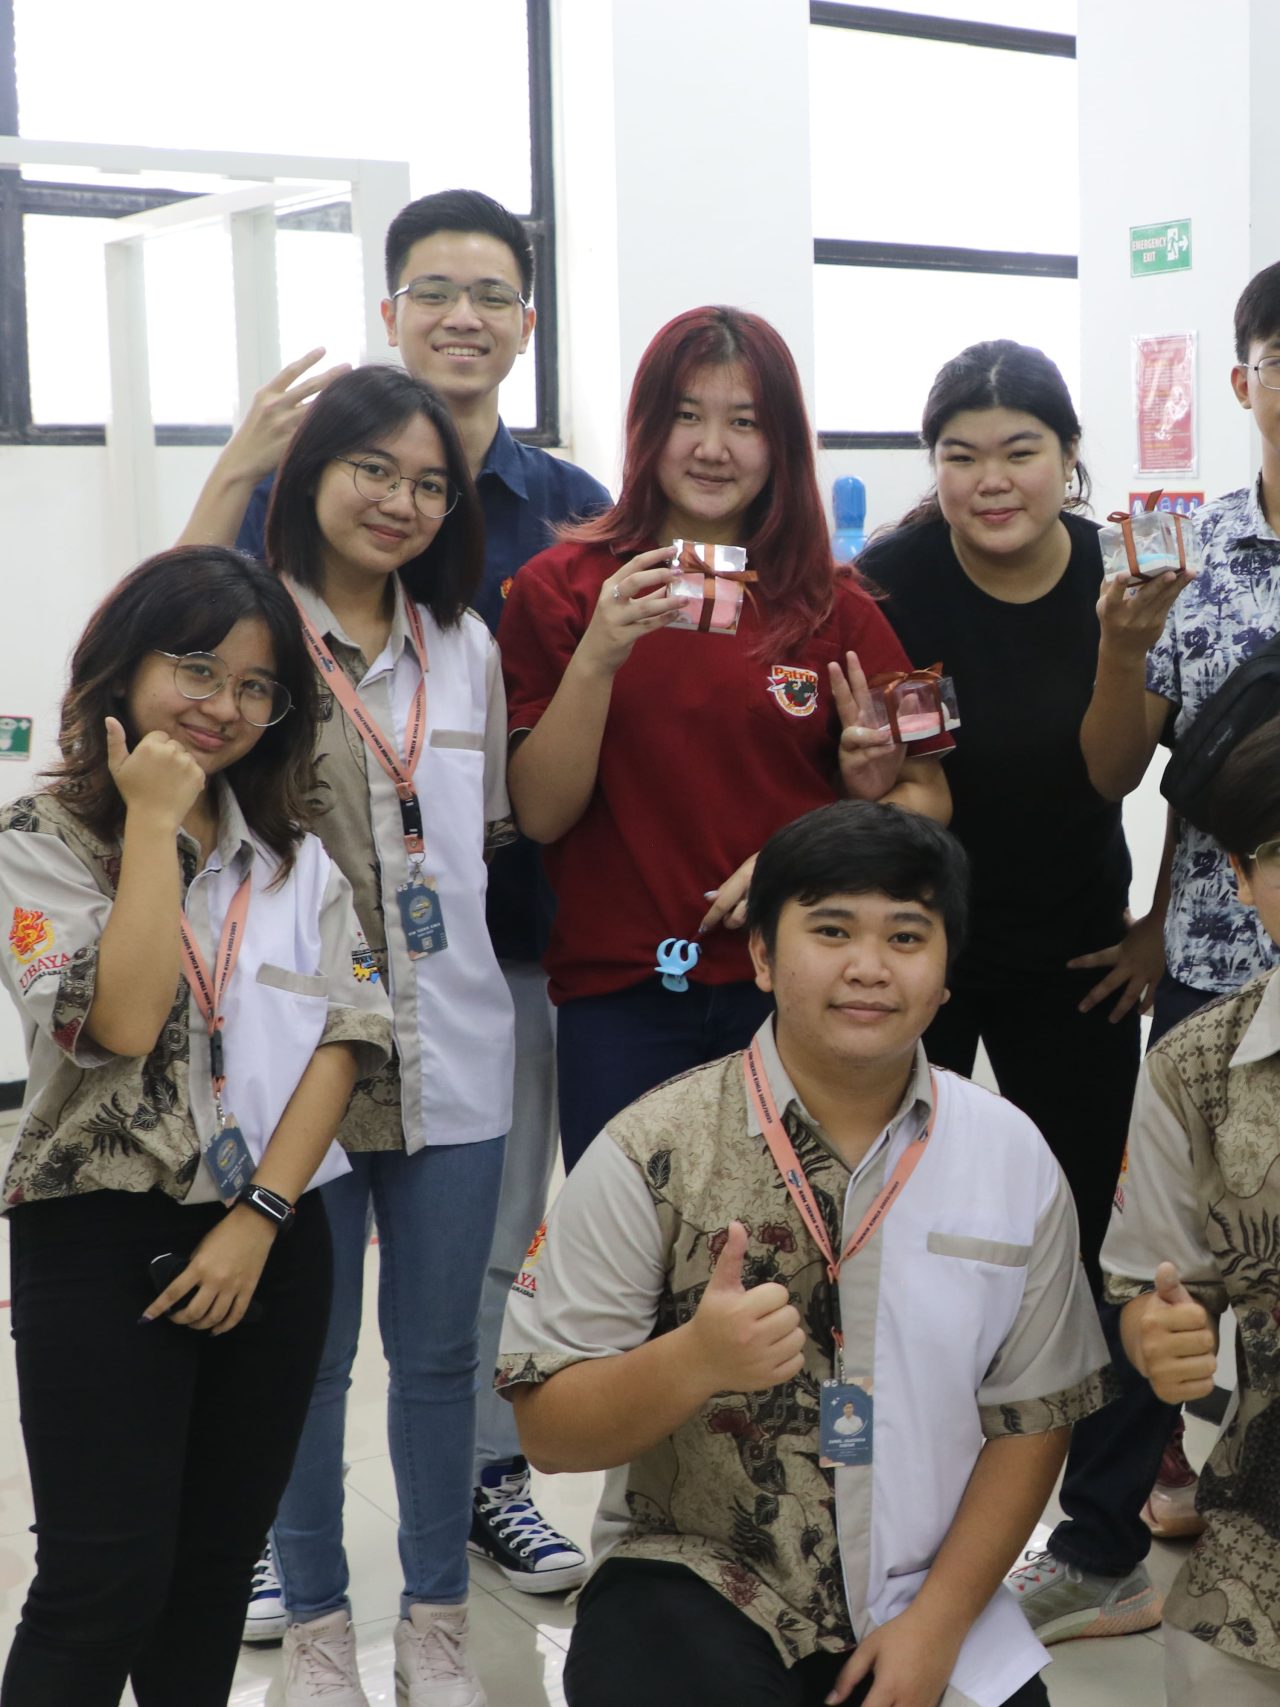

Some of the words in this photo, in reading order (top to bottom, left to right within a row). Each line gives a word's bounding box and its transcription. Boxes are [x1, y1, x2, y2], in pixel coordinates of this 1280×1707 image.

[1132, 237, 1167, 251] EMERGENCY
[1144, 252, 1156, 262] EXIT
[187, 950, 199, 969] KIMIA
[20, 952, 70, 988] UBAYA
